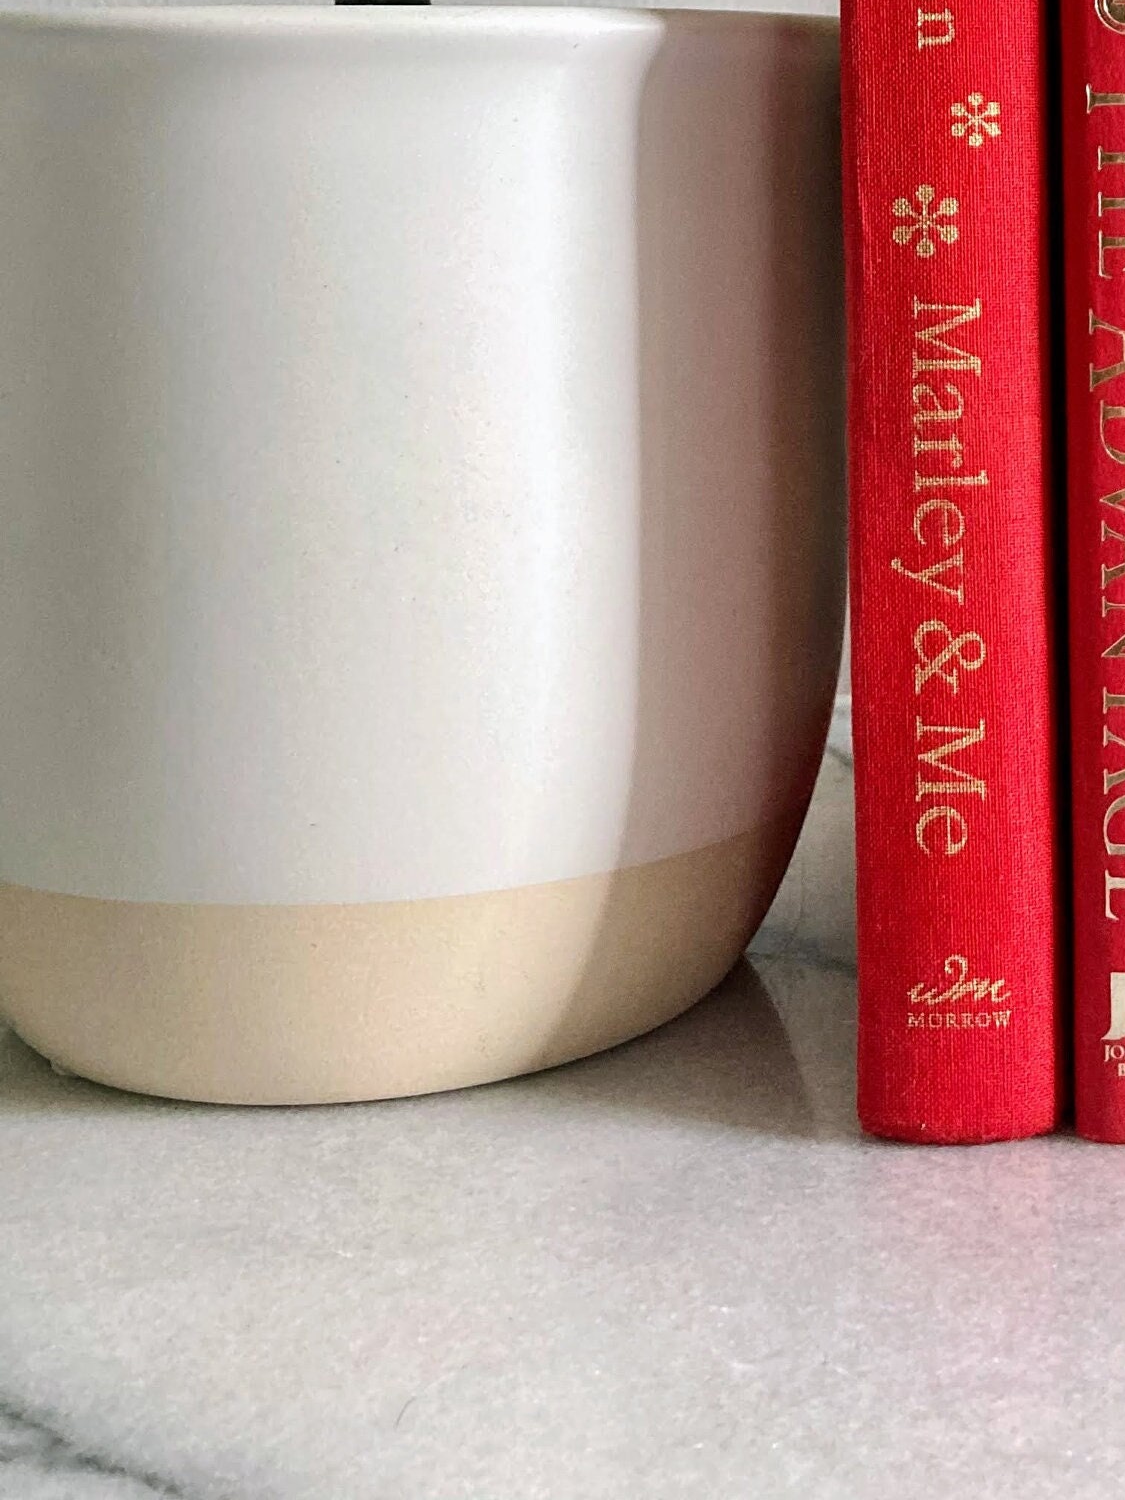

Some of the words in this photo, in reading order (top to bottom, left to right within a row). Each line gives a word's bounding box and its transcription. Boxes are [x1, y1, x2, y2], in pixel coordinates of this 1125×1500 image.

[888, 295, 987, 607] Marley
[913, 617, 987, 695] &
[915, 715, 988, 858] Me
[907, 1008, 1013, 1030] MORROW
